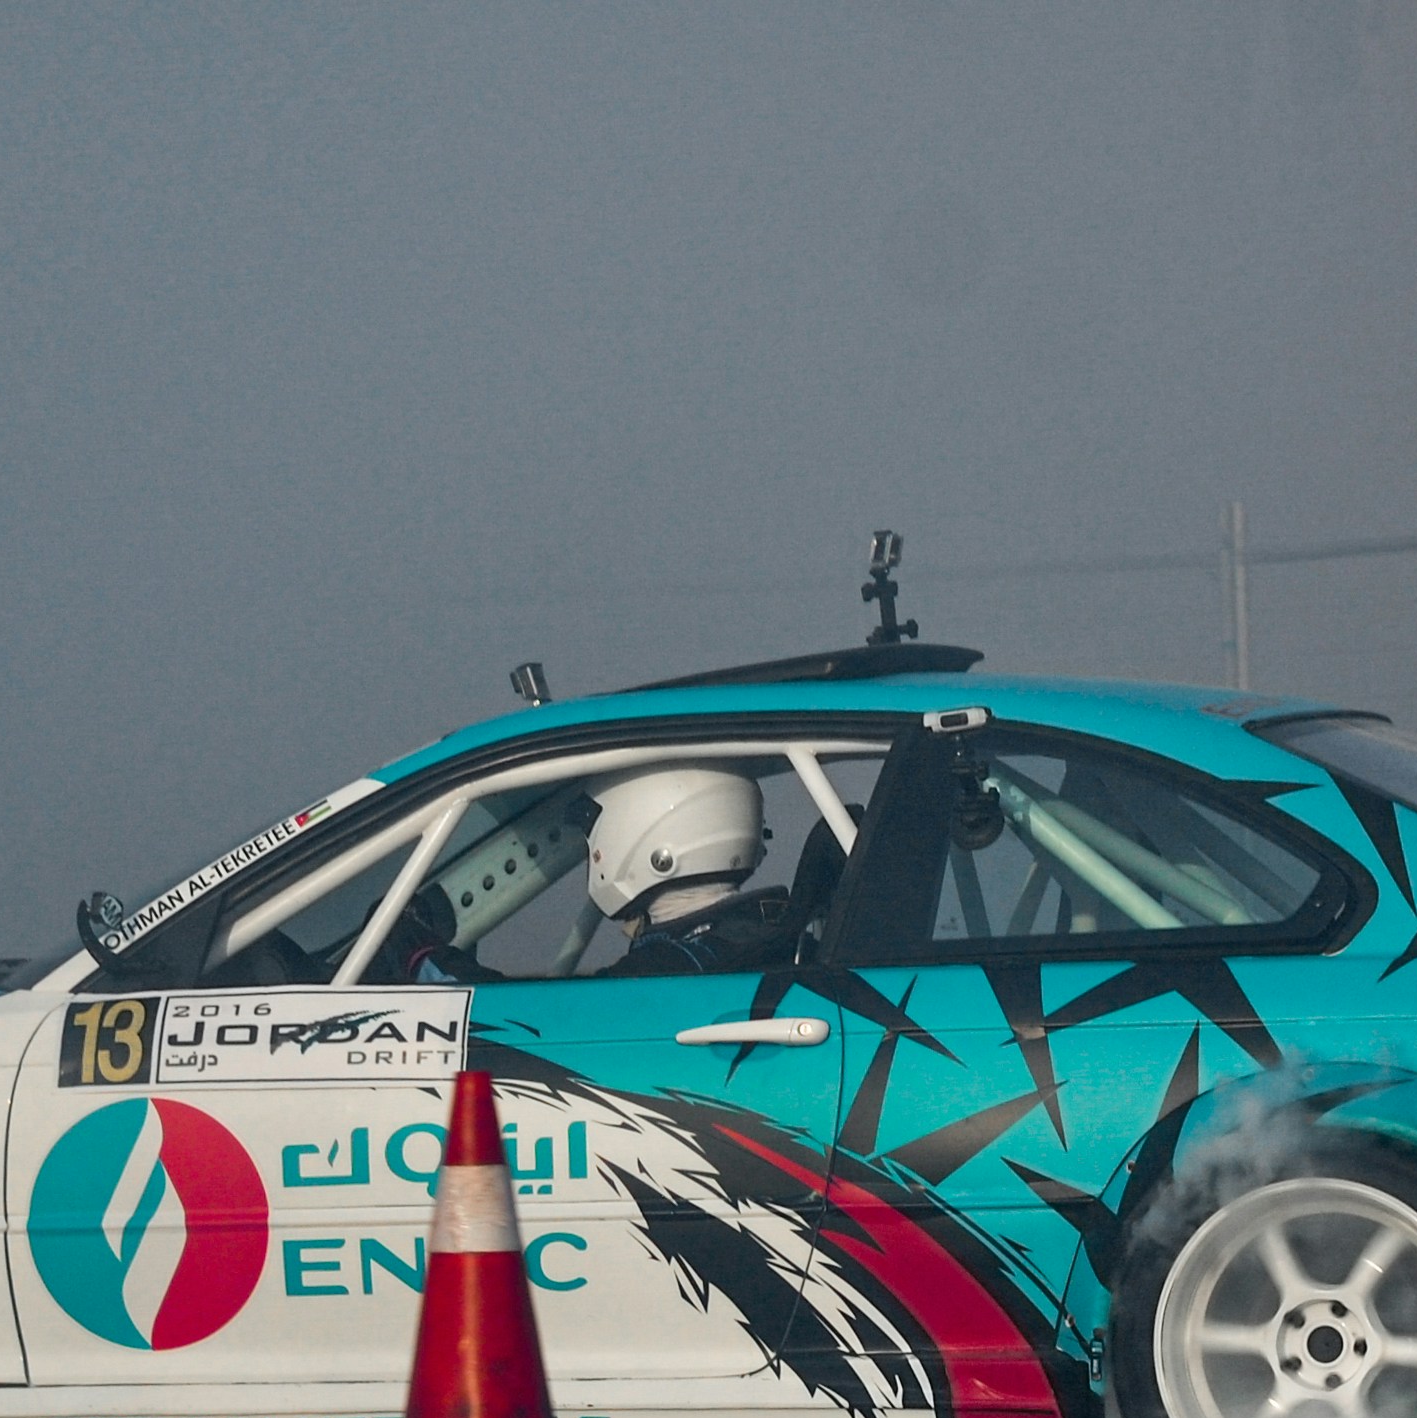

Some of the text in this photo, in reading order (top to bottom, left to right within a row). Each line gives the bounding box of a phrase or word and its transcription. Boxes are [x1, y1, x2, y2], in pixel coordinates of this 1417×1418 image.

[103, 888, 185, 950] OTHMAN
[188, 821, 297, 898] AL-TEKRETEE
[172, 1002, 272, 1018] 2016
[72, 998, 147, 1085] 13
[166, 1020, 459, 1050] JORDAN
[165, 1053, 219, 1073] درفت
[346, 1049, 456, 1065] DRIFT
[282, 1231, 588, 1297] ENC
